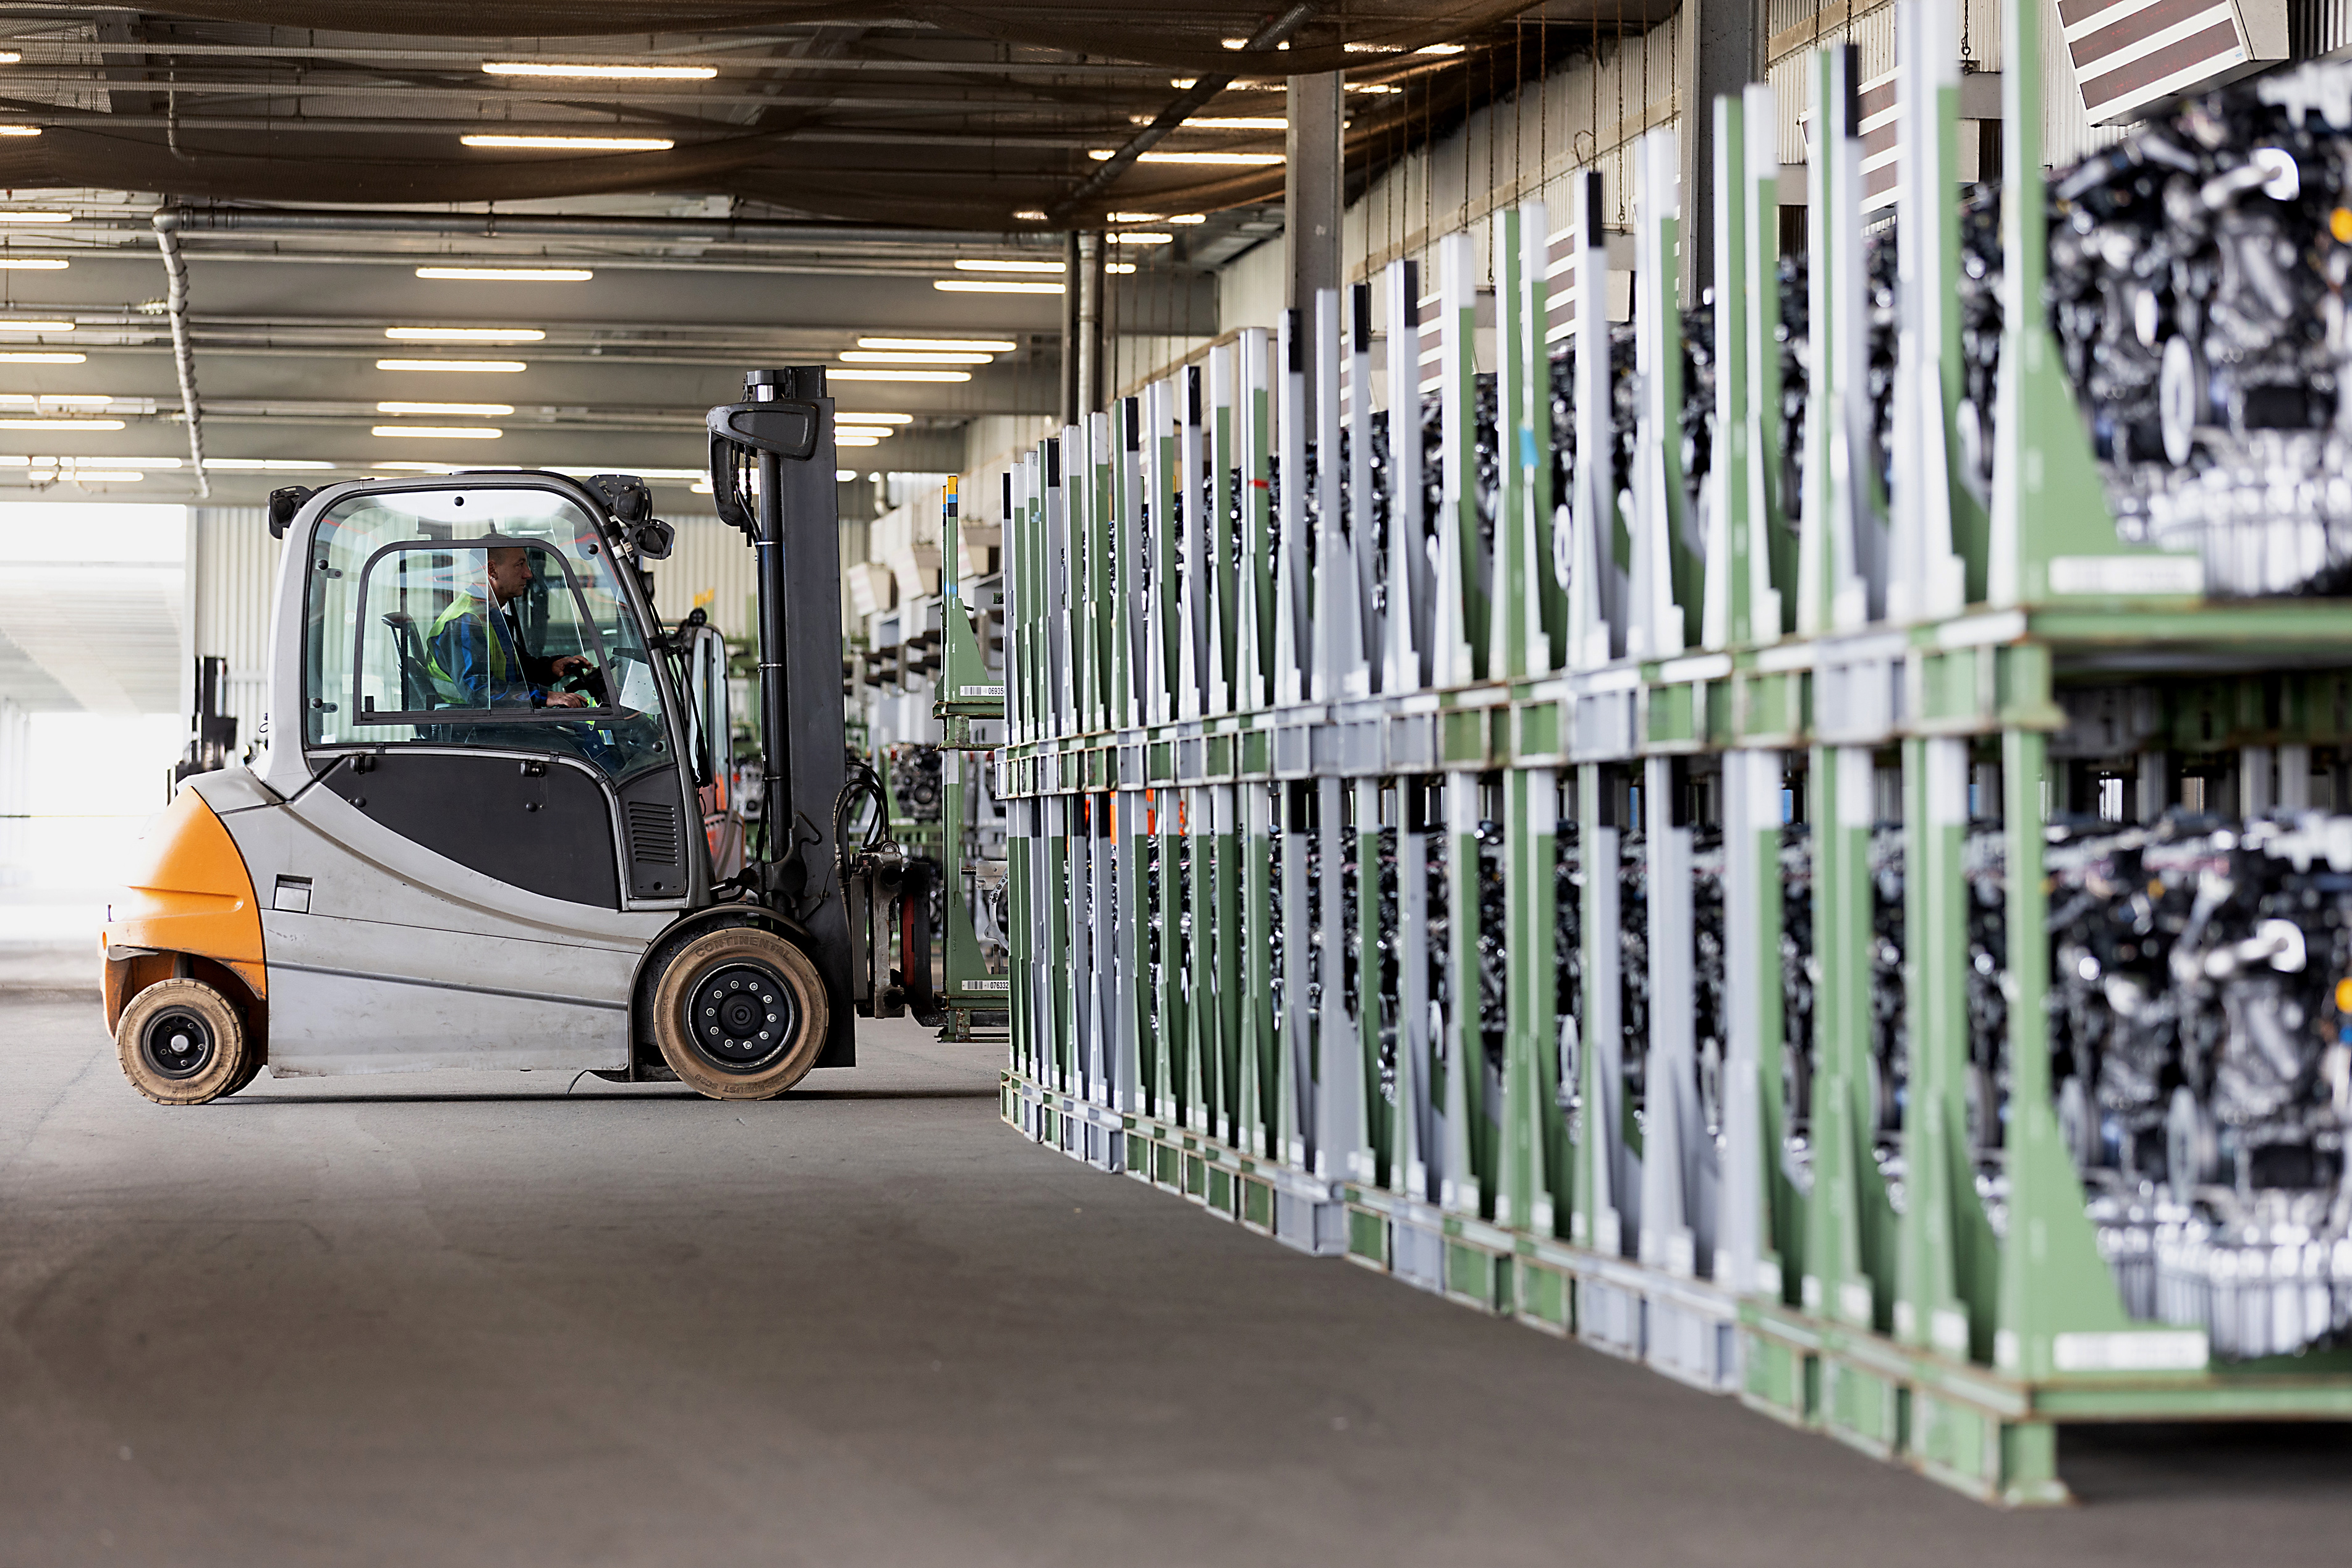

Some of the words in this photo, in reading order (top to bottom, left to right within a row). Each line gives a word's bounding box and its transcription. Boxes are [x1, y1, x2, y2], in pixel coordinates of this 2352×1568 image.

[695, 936, 791, 960] CONTINENTAL
[694, 1074, 718, 1090] SC20
[723, 1075, 787, 1093] CSE-ROBUST
